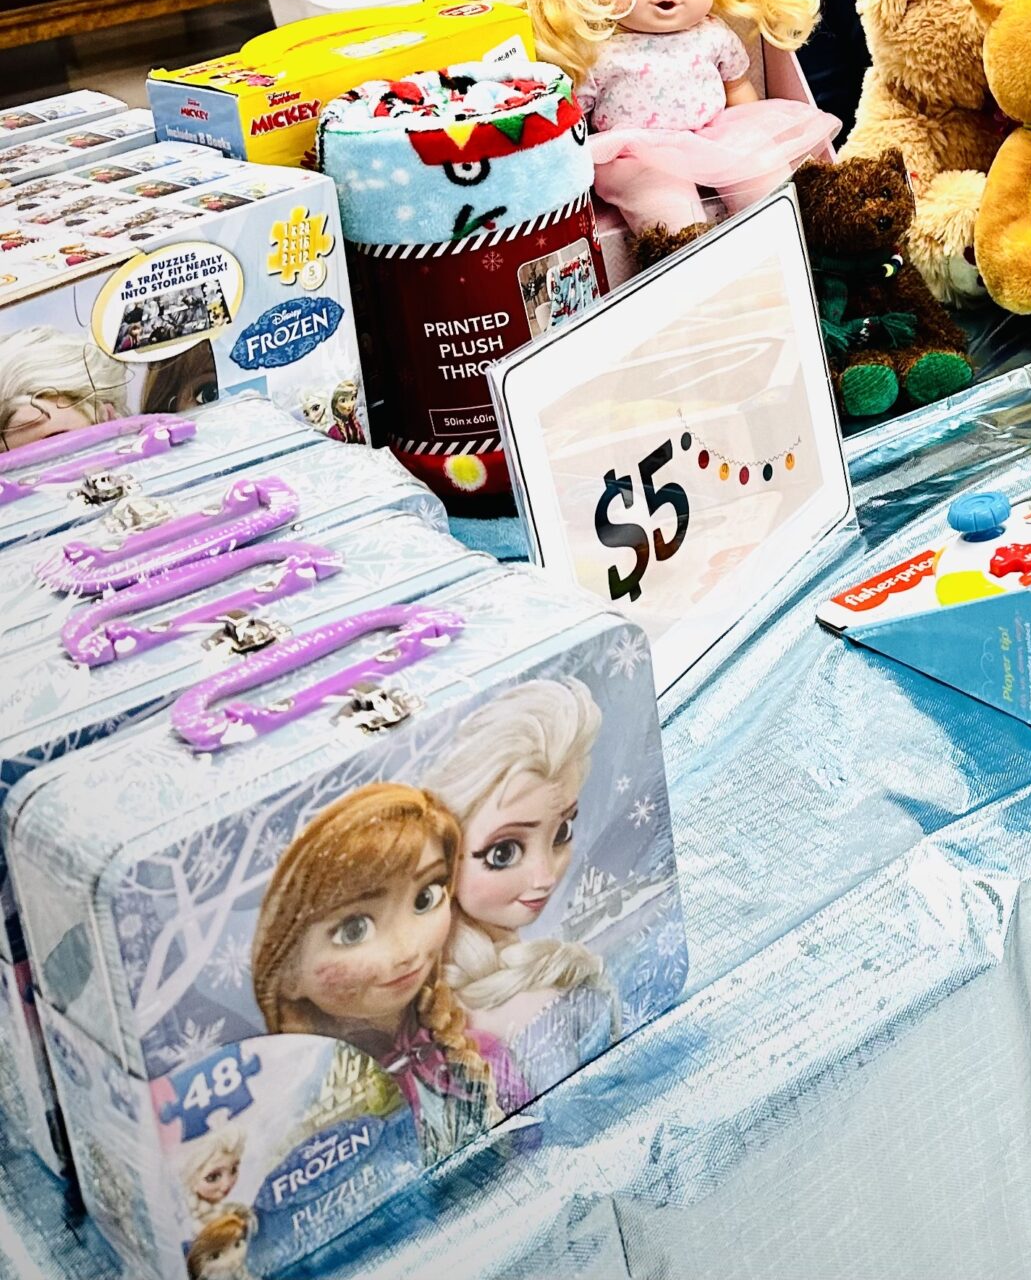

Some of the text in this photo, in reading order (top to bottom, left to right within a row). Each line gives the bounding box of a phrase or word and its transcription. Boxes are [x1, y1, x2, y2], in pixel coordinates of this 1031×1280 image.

[180, 106, 208, 121] MICKEY
[250, 100, 321, 136] MICKEY
[125, 254, 222, 289] & TRAY FIT NEATLY
[151, 252, 197, 272] PUZZLES
[121, 262, 228, 300] INTO STORAGE BOX!
[246, 308, 329, 361] FROZEN
[270, 309, 302, 325] Disney
[424, 311, 510, 337] PRINTED
[439, 335, 504, 358] PLUSH
[438, 358, 497, 380] THRO
[444, 416, 465, 426] 50in
[473, 414, 495, 424] 60in
[595, 439, 690, 602] $5
[844, 558, 934, 606] fisher-pric
[1024, 622, 1031, 653] unlock
[998, 626, 1014, 702] Player tip!
[183, 1057, 242, 1110] 48
[272, 1125, 371, 1204] FROZEN
